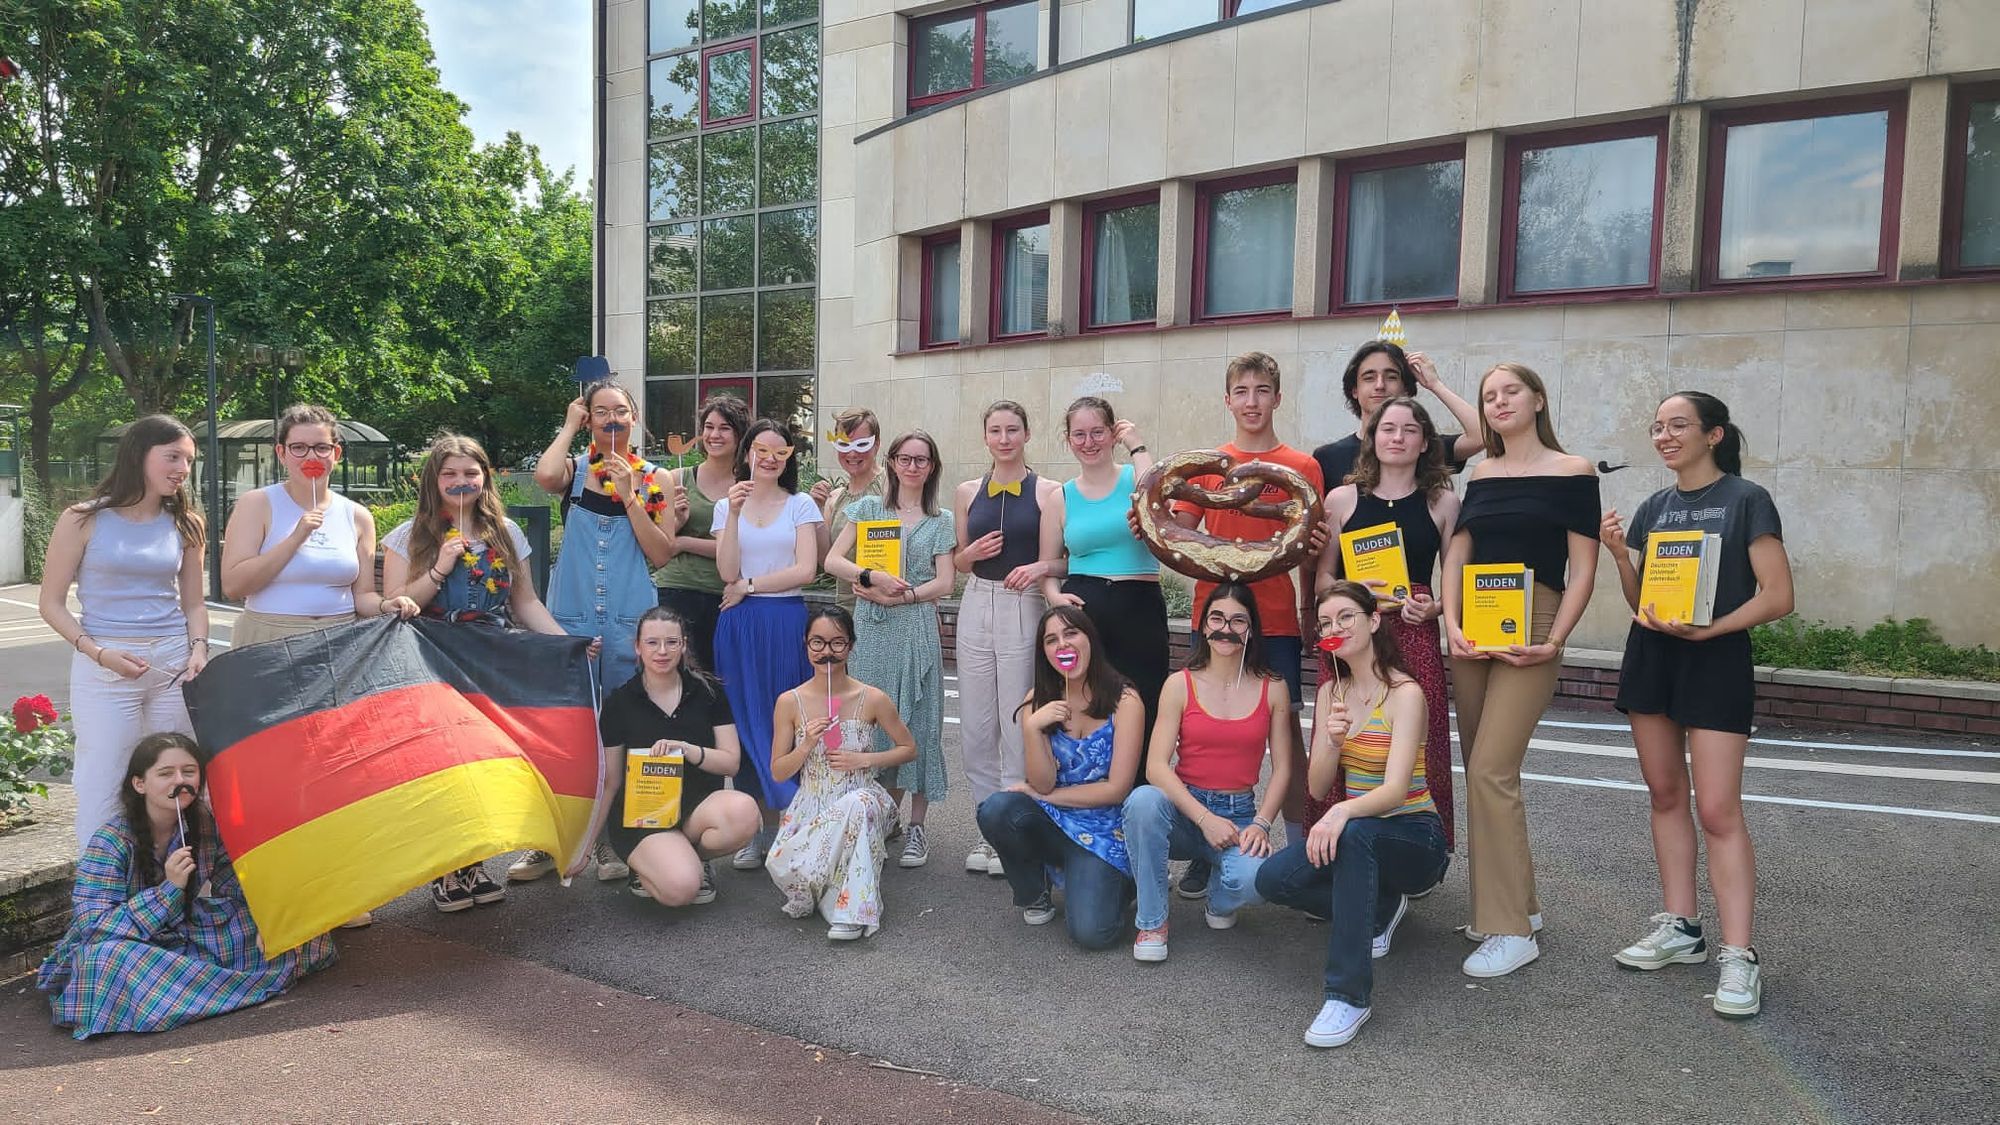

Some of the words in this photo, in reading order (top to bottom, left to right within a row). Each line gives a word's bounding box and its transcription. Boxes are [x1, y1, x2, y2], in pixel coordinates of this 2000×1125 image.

[868, 530, 896, 539] DUDEN
[1354, 536, 1392, 553] DUDEN
[1658, 545, 1694, 556] DUDEN
[1476, 578, 1516, 588] DUDEN
[643, 765, 677, 775] DUDEN
